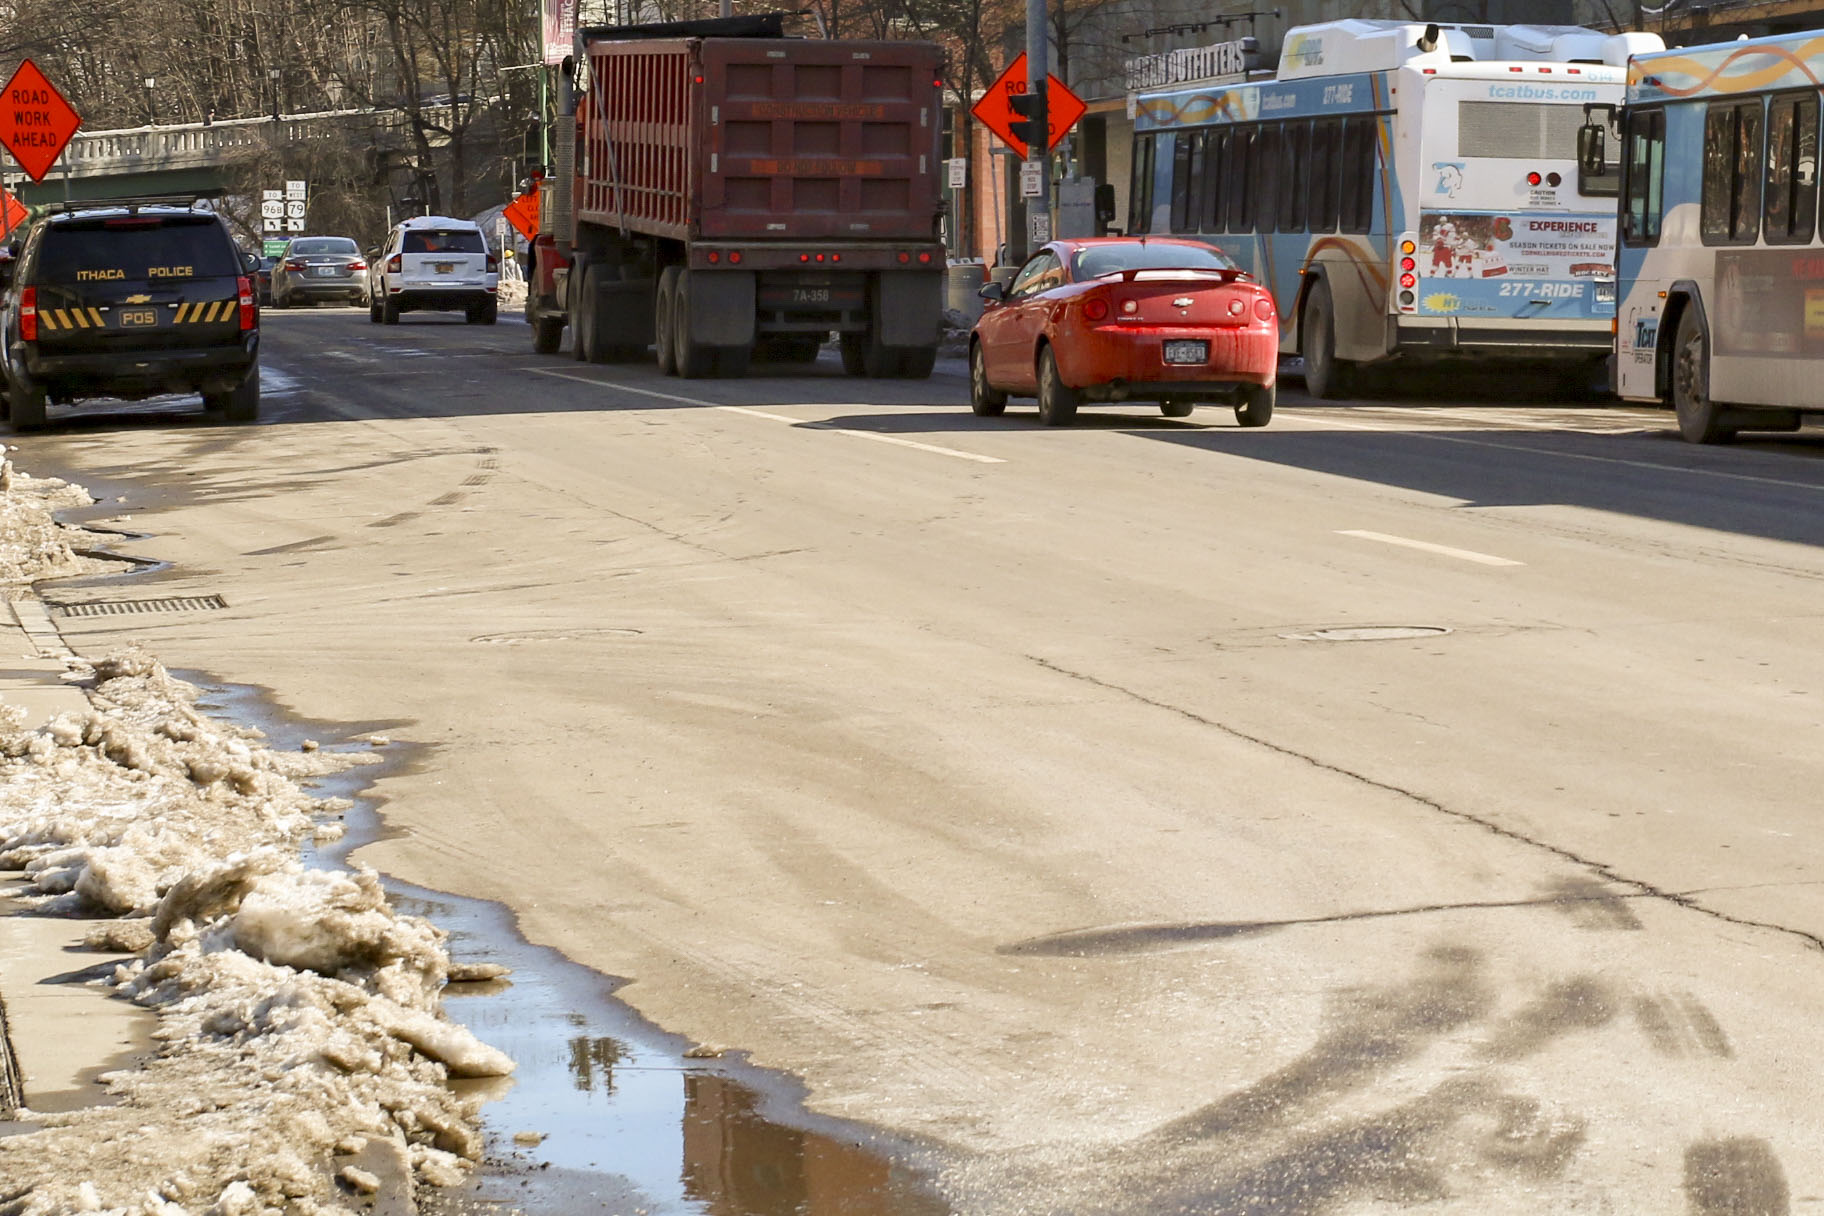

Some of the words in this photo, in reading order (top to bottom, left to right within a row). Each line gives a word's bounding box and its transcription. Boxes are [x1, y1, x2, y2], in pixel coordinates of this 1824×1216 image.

[1168, 40, 1246, 83] OUTFITTERS
[12, 89, 49, 104] ROAD
[1489, 84, 1597, 101] tcatbus.com
[13, 111, 51, 126] WORK
[12, 131, 57, 147] AHEAD
[263, 205, 282, 214] 96B
[289, 204, 304, 214] 79
[1529, 221, 1598, 233] EXPERIENCE
[77, 269, 125, 281] ITHACA
[148, 266, 193, 278] POLICE
[1499, 283, 1584, 299] 277-RIDE
